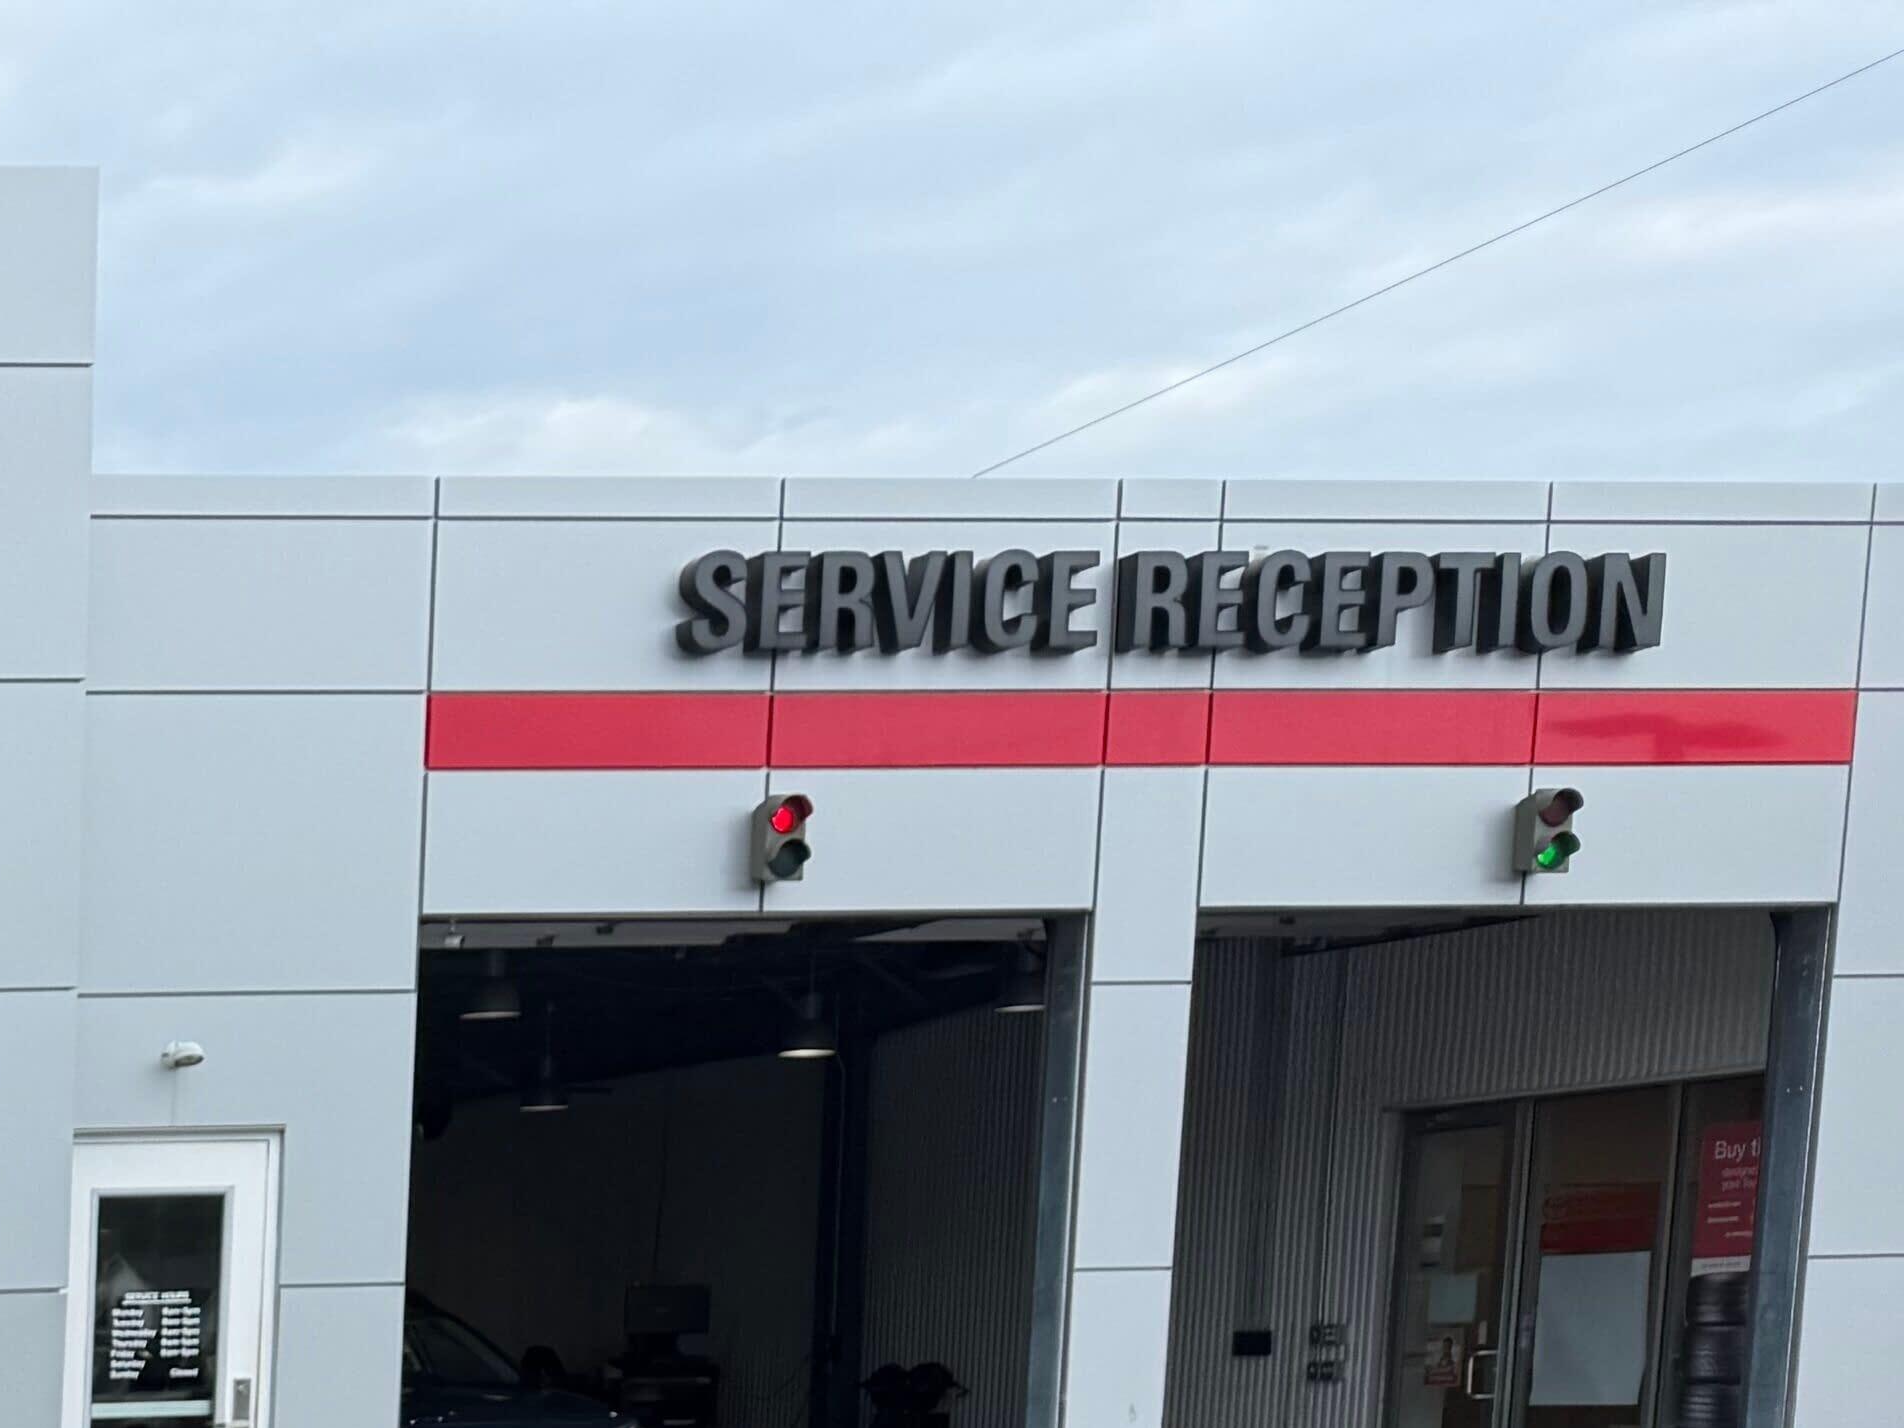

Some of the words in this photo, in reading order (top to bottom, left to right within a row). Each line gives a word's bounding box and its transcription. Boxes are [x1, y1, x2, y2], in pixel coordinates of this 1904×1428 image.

[676, 549, 1100, 654] SERVICE
[1117, 549, 1666, 653] RECEPTION
[1713, 1139, 1745, 1162] Buy
